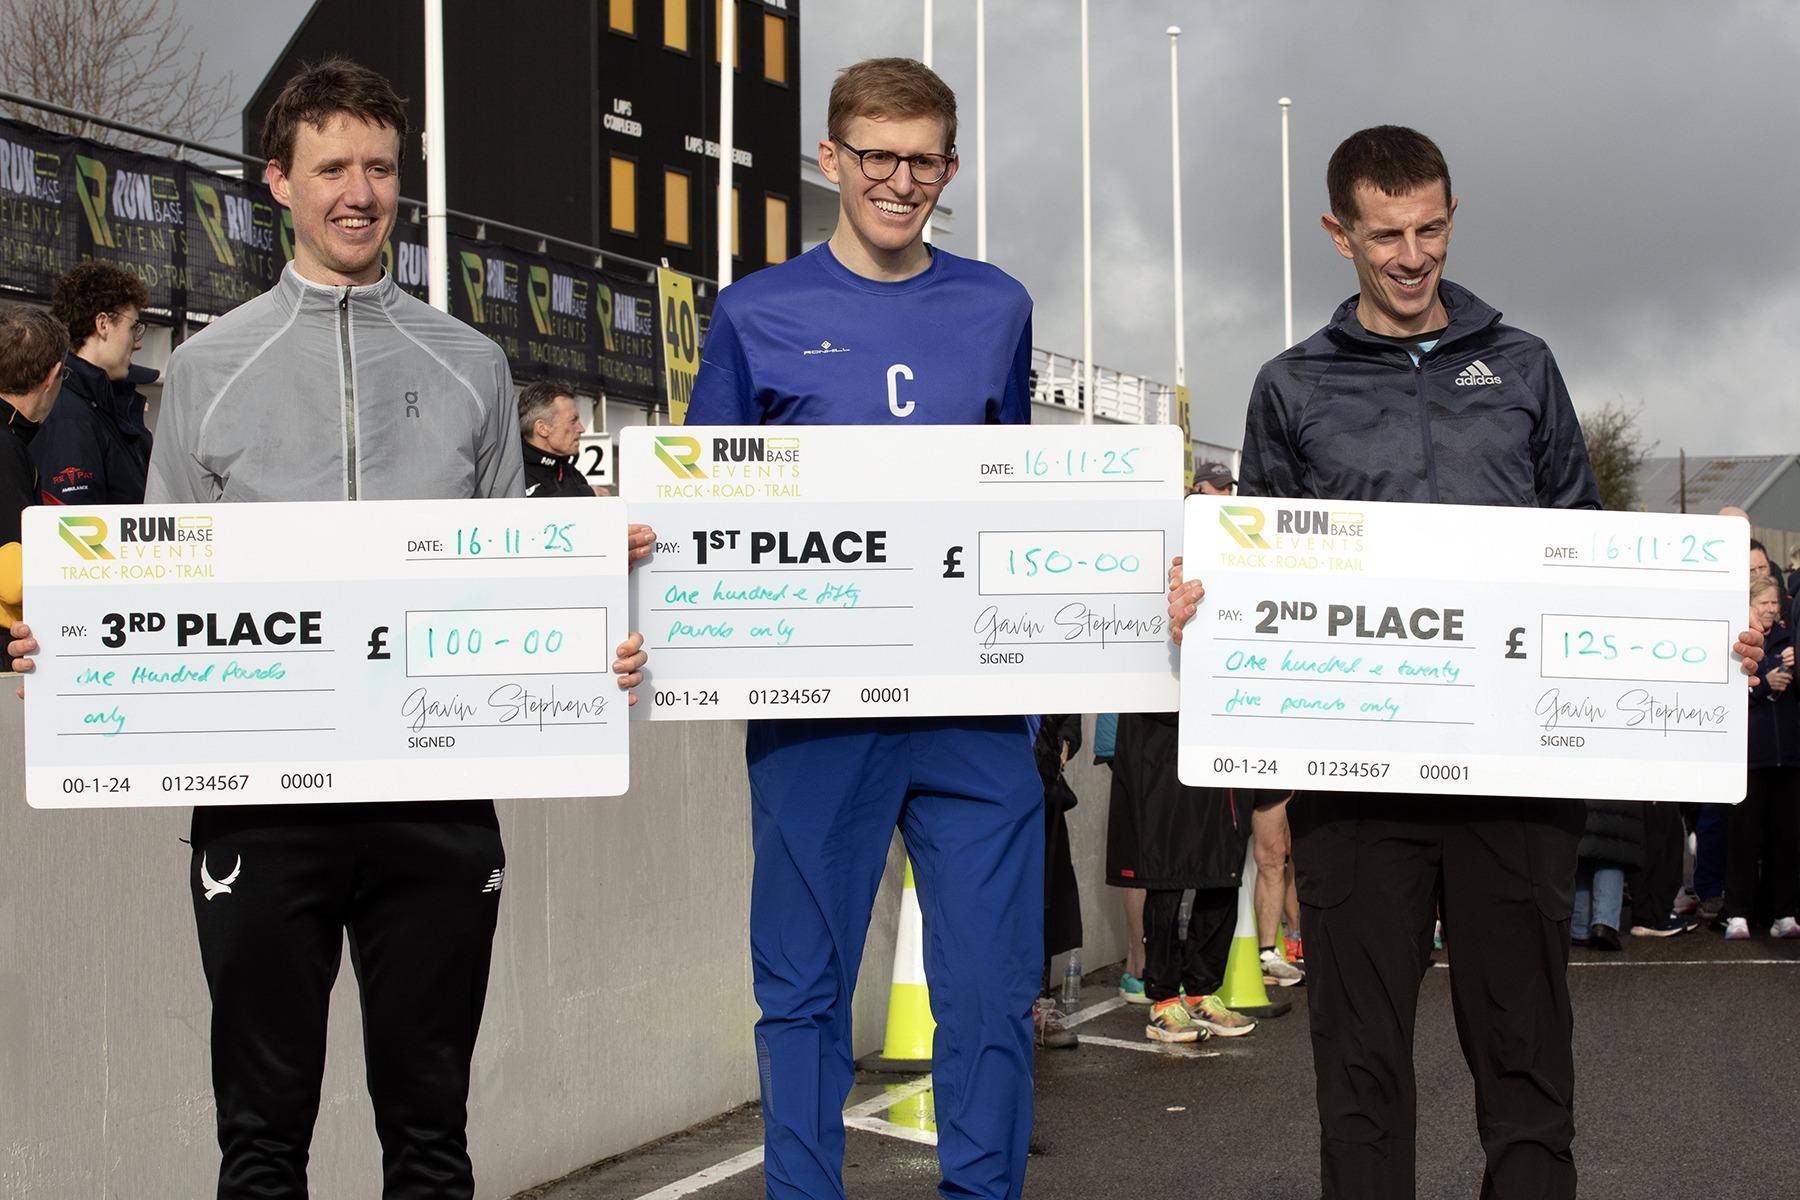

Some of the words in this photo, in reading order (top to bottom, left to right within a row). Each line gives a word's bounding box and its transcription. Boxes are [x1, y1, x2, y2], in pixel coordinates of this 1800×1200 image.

[0, 138, 37, 198] RUN
[112, 169, 155, 221] RUN
[153, 200, 184, 225] BASE
[1, 196, 62, 235] EVENTS
[224, 194, 253, 246] RUN
[115, 223, 189, 255] EVENTS
[552, 272, 574, 316] RUN
[614, 291, 636, 334] RUN
[666, 296, 695, 364] 40
[670, 367, 697, 404] MIN
[886, 363, 916, 418] C
[1455, 375, 1502, 386] adidas
[584, 445, 605, 476] 2
[713, 438, 764, 463] RUN
[767, 450, 800, 463] BASE
[713, 465, 800, 479] EVENTS
[980, 463, 1014, 475] DATE:
[120, 516, 176, 542] RUN
[177, 529, 213, 542] BASE
[1277, 509, 1329, 535] RUN
[1330, 524, 1364, 537] BASE
[120, 544, 214, 560] EVENTS
[407, 540, 444, 553] DATE:
[655, 543, 680, 554] PAY:
[692, 530, 741, 565] 1ST
[750, 530, 887, 564] PLACE
[1275, 537, 1364, 552] EVENTS
[1544, 547, 1578, 560] DATE:
[943, 546, 965, 578] £
[664, 584, 700, 605] One
[712, 580, 787, 602] hundred
[61, 626, 88, 638] PAY:
[101, 611, 166, 649] 3RD
[177, 610, 323, 648] PLACE
[667, 620, 734, 642] pounds
[750, 618, 795, 645] only
[974, 606, 1044, 649] Gavin
[1053, 602, 1166, 650] Stephens
[1218, 609, 1243, 622] PAY:
[1255, 600, 1318, 635] 2ND
[1327, 604, 1464, 642] PLACE
[367, 626, 392, 660] £
[979, 652, 1025, 664] SIGNED
[1505, 627, 1527, 660] £
[131, 664, 216, 685] Hundred
[1225, 650, 1268, 672] One
[1280, 649, 1362, 675] hundred
[1397, 660, 1461, 684] twenty
[401, 687, 478, 733] Gavin
[488, 684, 609, 733] Stephens
[654, 690, 720, 706] 00-1-24
[748, 688, 832, 705] 01234567
[860, 687, 910, 703] 00001
[1359, 697, 1400, 721] only
[83, 705, 126, 738] only
[1535, 688, 1606, 731] Gavin
[1616, 689, 1729, 737] Stephens
[408, 736, 456, 749] SIGNED
[1540, 736, 1586, 749] SIGNED
[62, 777, 132, 794] 00-1-24
[161, 774, 250, 792] 01234567
[280, 772, 334, 789] 00001
[1213, 757, 1279, 776] 00-1-24
[1307, 760, 1391, 779] 01234567
[1419, 764, 1470, 781] 00001
